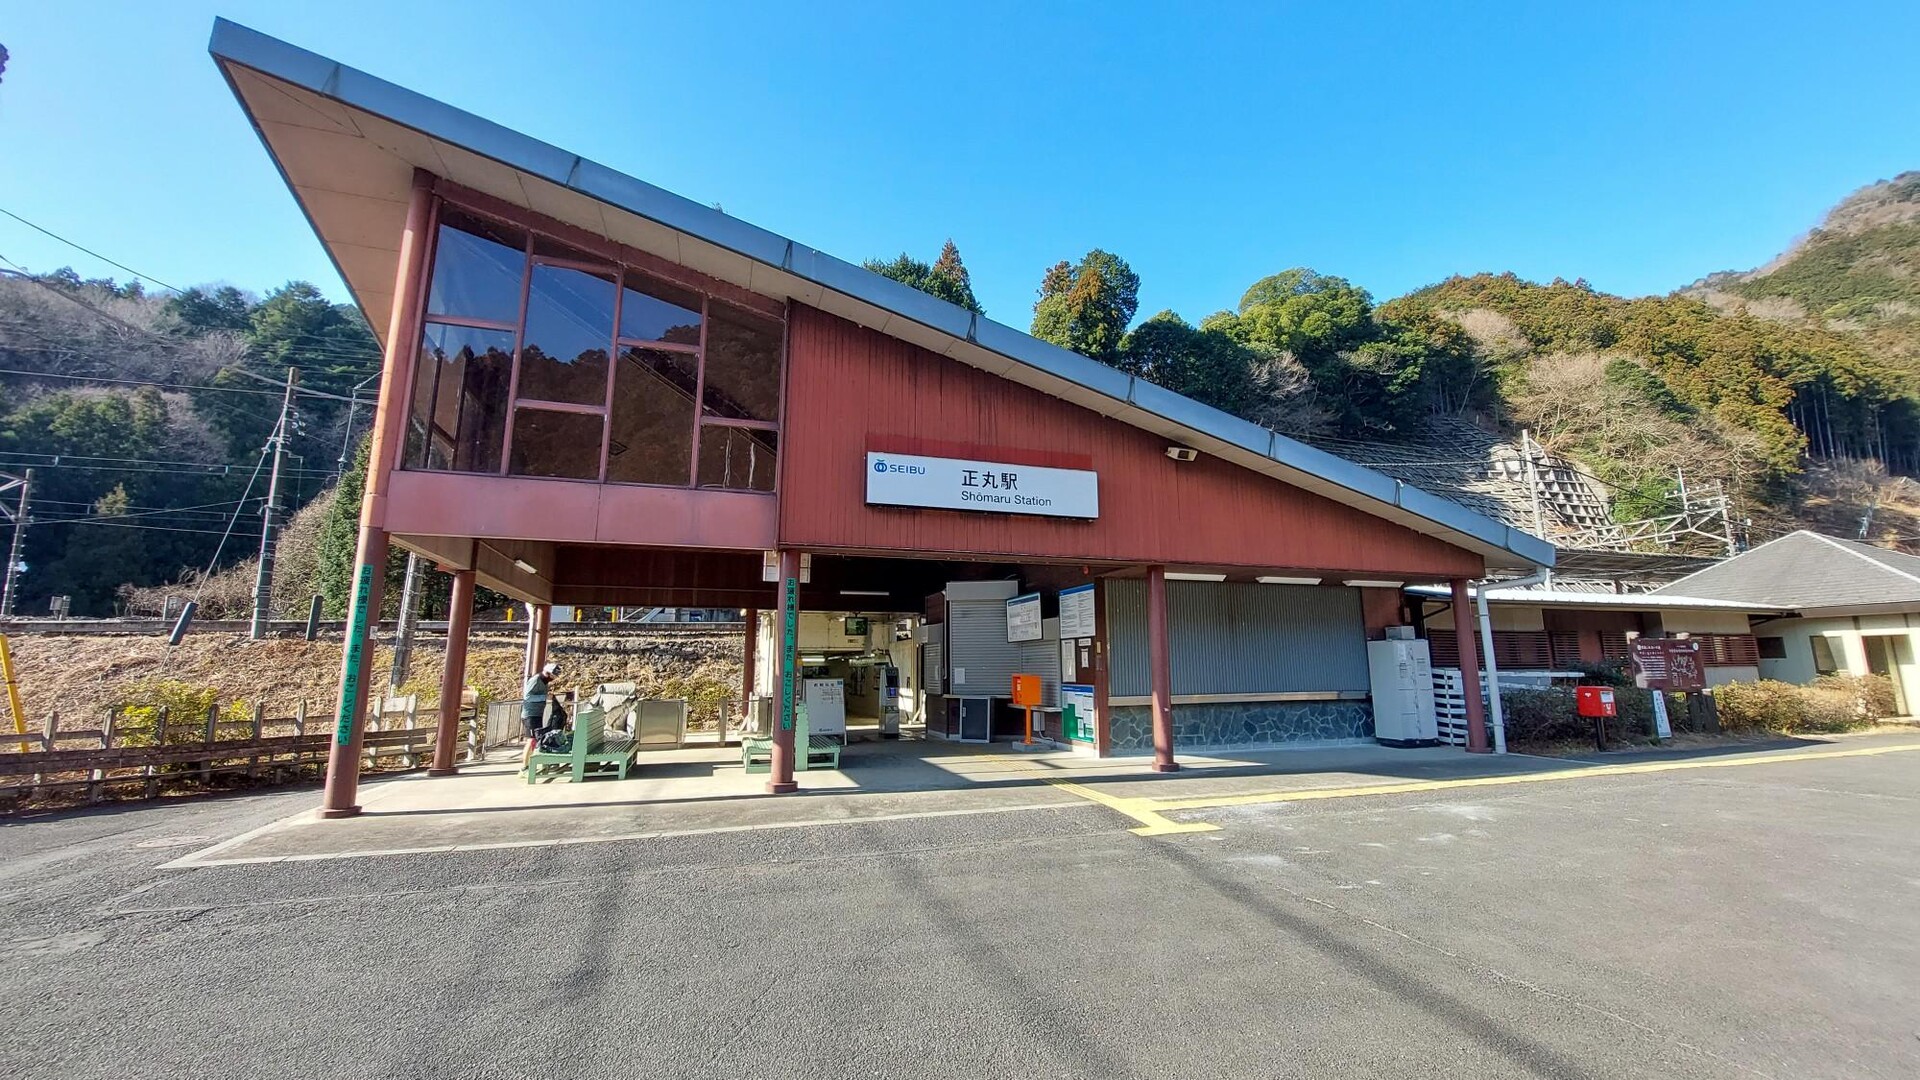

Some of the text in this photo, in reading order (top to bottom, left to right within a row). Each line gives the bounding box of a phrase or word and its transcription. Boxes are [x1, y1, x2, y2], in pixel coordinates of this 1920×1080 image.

[889, 464, 926, 475] SEIBU
[961, 469, 1018, 491] 正丸駅
[1014, 494, 1052, 507] Station
